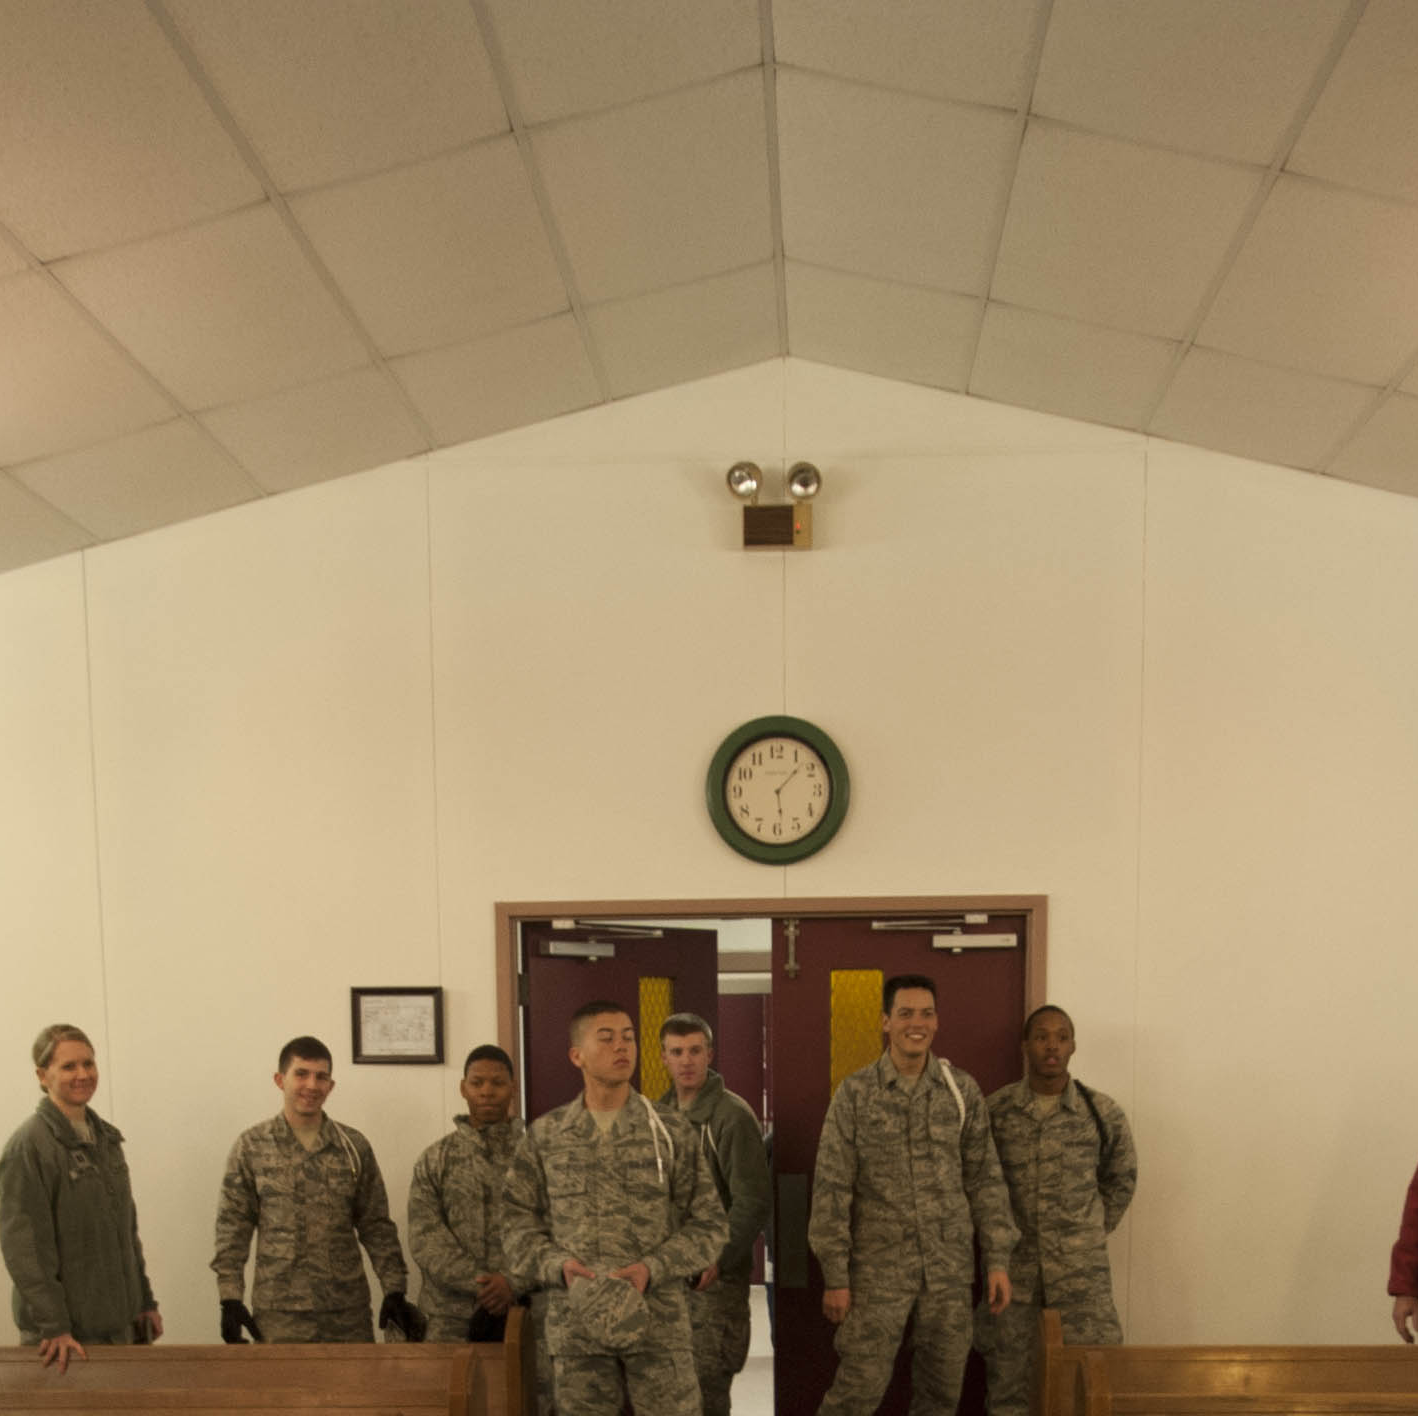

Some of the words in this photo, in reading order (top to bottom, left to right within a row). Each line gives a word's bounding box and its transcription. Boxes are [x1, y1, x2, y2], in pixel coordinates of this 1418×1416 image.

[751, 752, 763, 766] 11
[769, 744, 784, 759] 12
[738, 767, 753, 781] 10
[806, 763, 816, 778] 2
[732, 784, 743, 799] 9
[812, 783, 822, 797] 3
[739, 804, 750, 818] 8
[754, 817, 764, 833] 7
[772, 822, 782, 837] 6
[791, 817, 801, 832] 5
